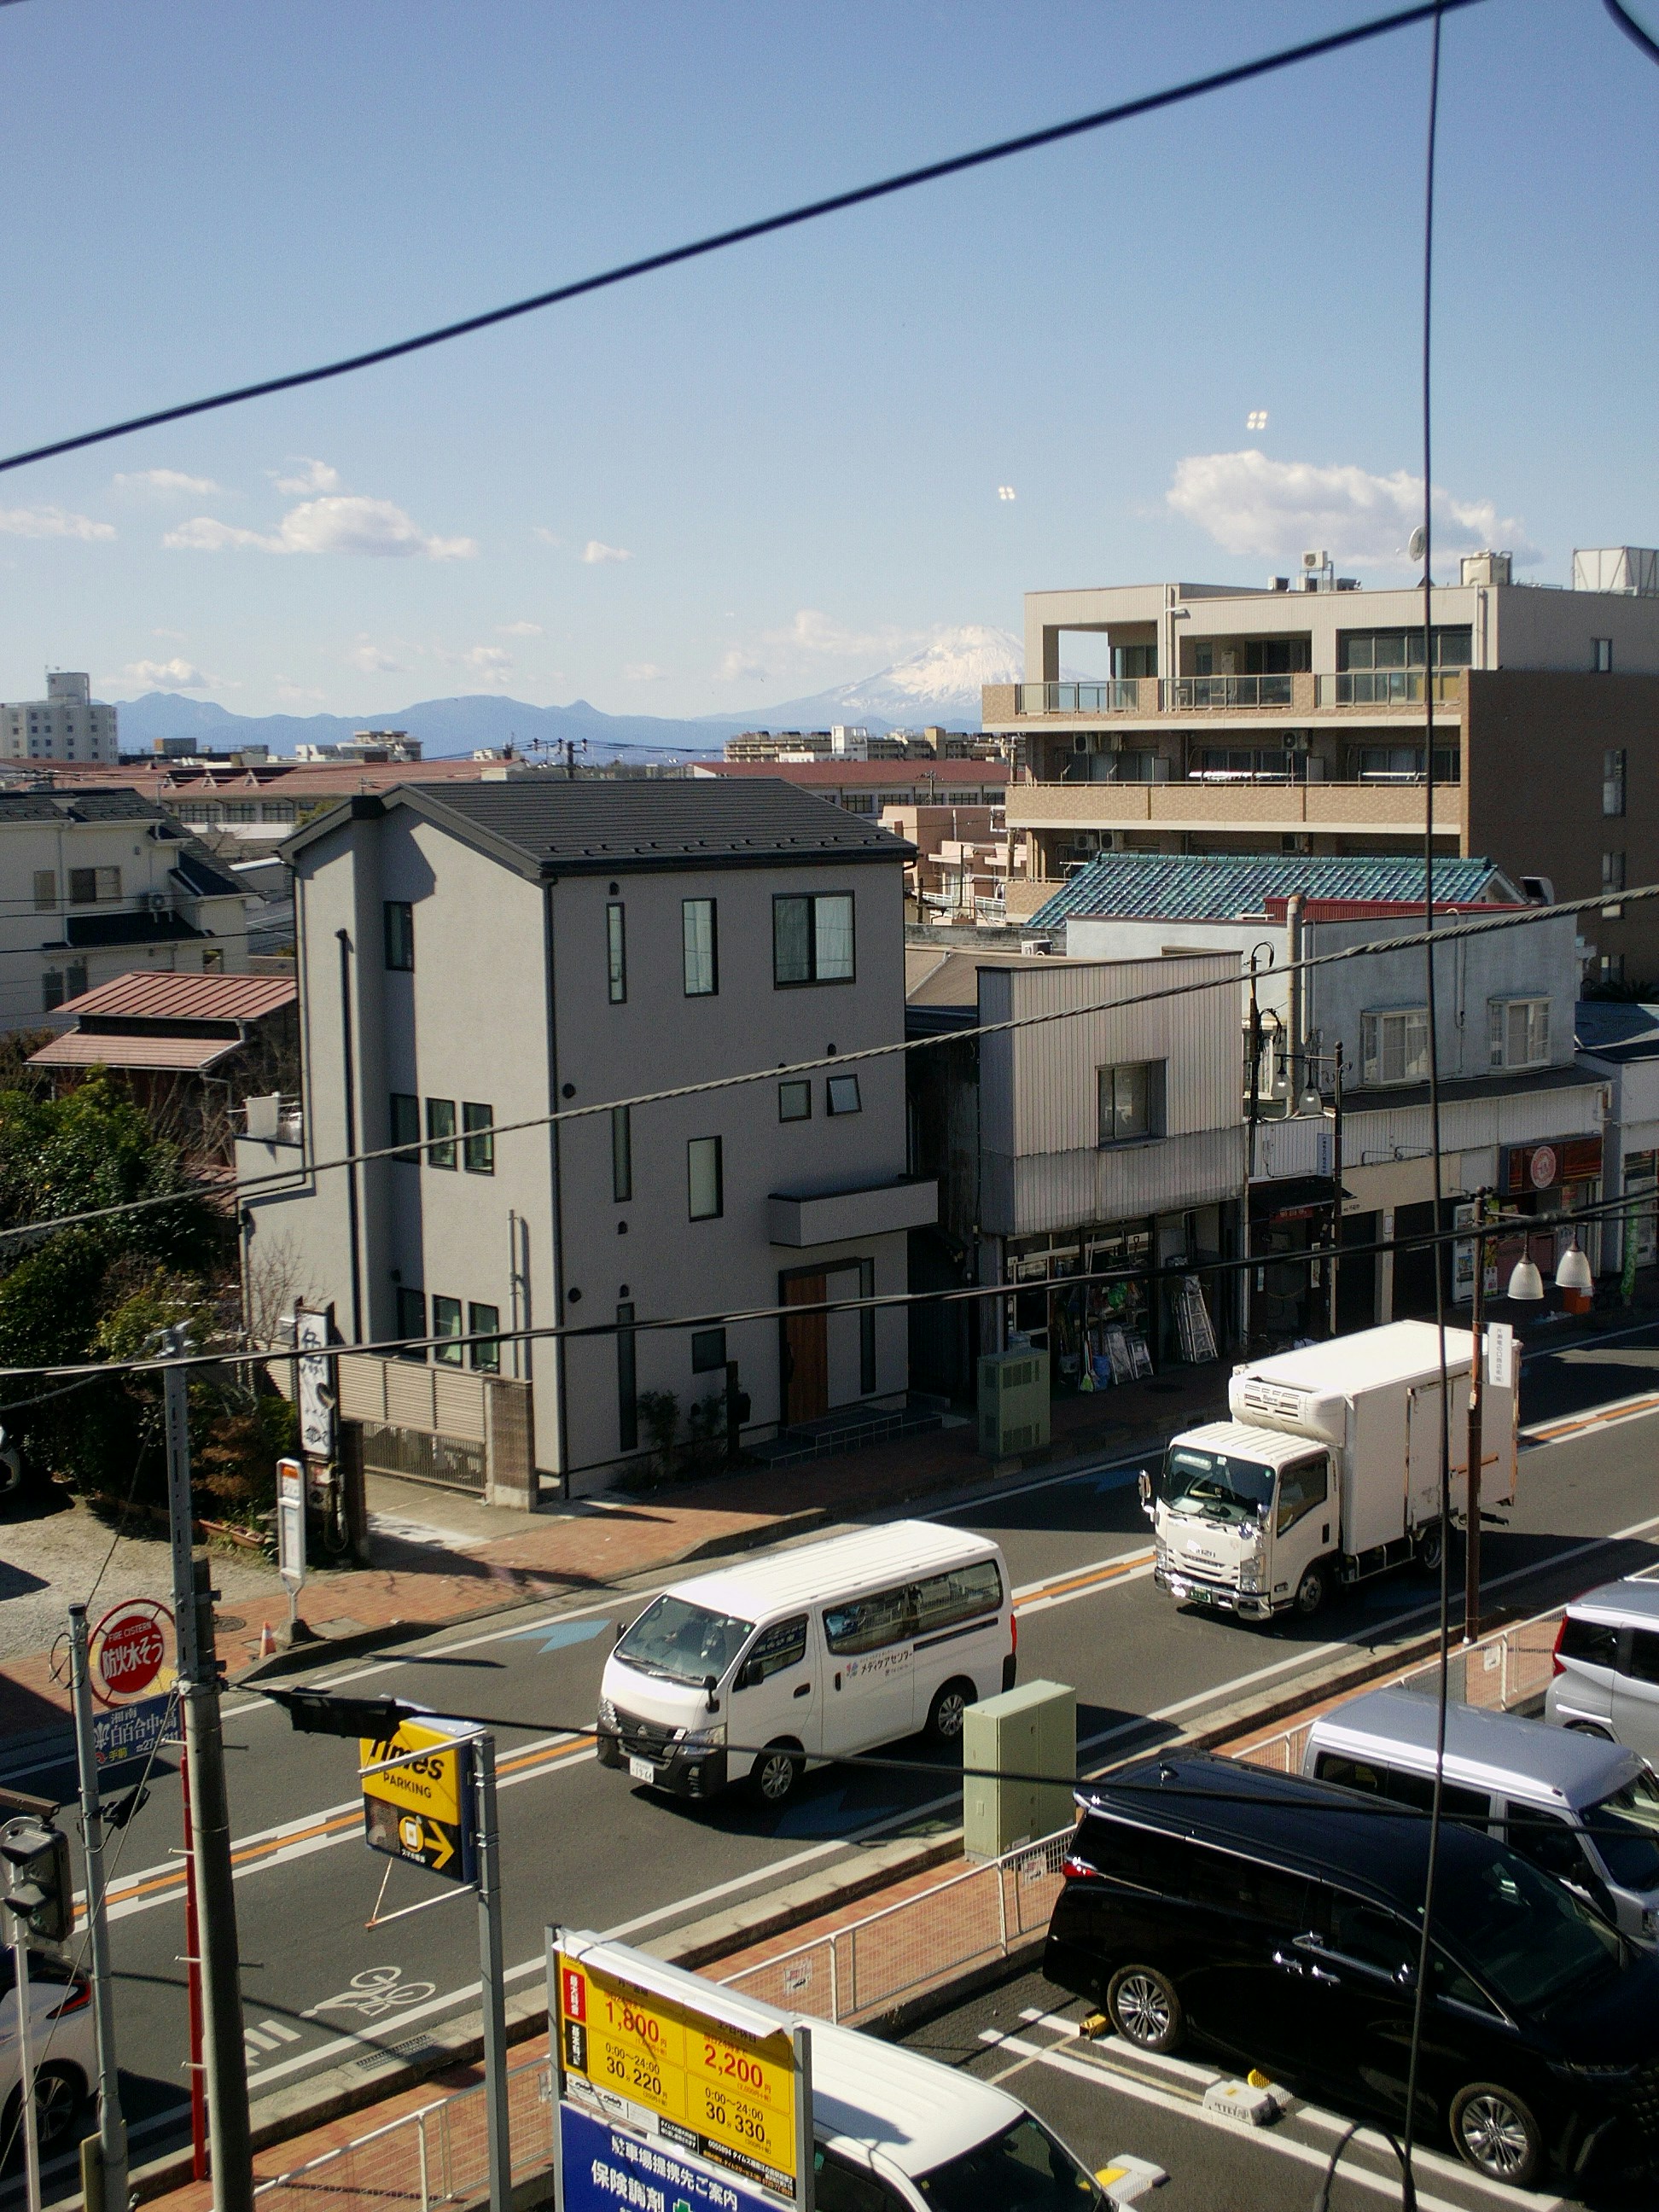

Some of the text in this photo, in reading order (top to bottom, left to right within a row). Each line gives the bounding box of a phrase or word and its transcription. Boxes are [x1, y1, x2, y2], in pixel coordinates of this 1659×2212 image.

[108, 1621, 152, 1643] FIRE CISTERN
[102, 1634, 163, 1679] 防火水そう
[861, 1650, 913, 1675] メディケアセンター
[111, 1706, 137, 1725] 湘南
[383, 1772, 432, 1799] PARKING
[591, 2157, 665, 2212] 保険調剤
[611, 2134, 738, 2211] 駐車場提携先ご案内
